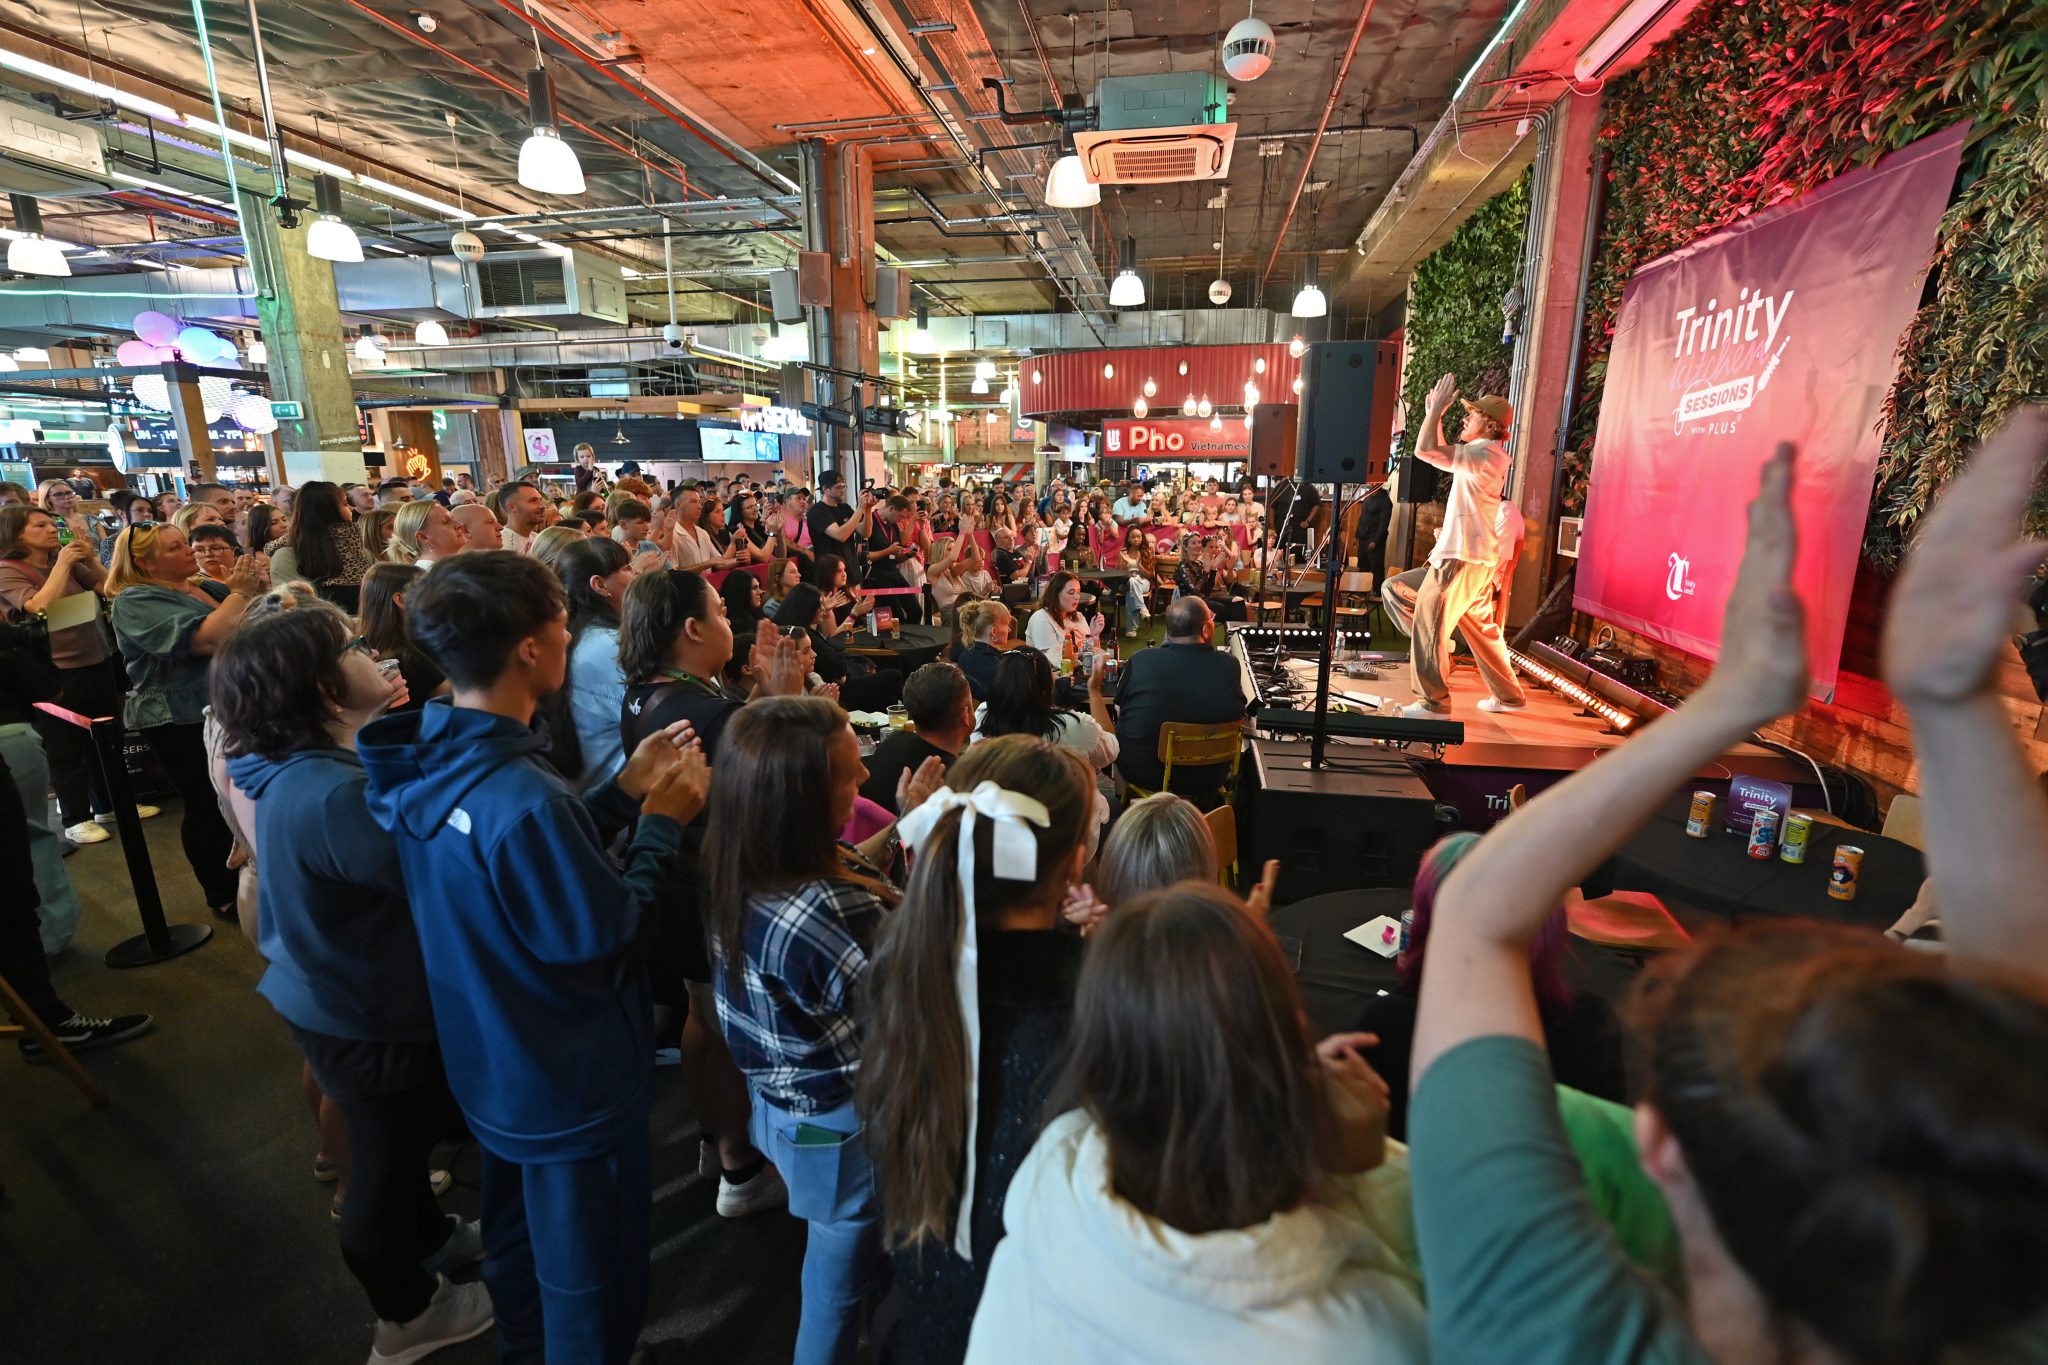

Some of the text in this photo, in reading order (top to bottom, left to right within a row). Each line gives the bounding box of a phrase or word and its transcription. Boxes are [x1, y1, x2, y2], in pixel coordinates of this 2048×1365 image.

[1674, 287, 1795, 358] Trinity
[1669, 337, 1769, 392] kitchen
[1684, 383, 1749, 414] SESSIONS
[1013, 428, 1035, 440] Pho
[1129, 426, 1184, 451] Pho
[1708, 421, 1737, 435] PLUS
[1484, 794, 1509, 810] Tri
[1739, 787, 1776, 805] Trinity
